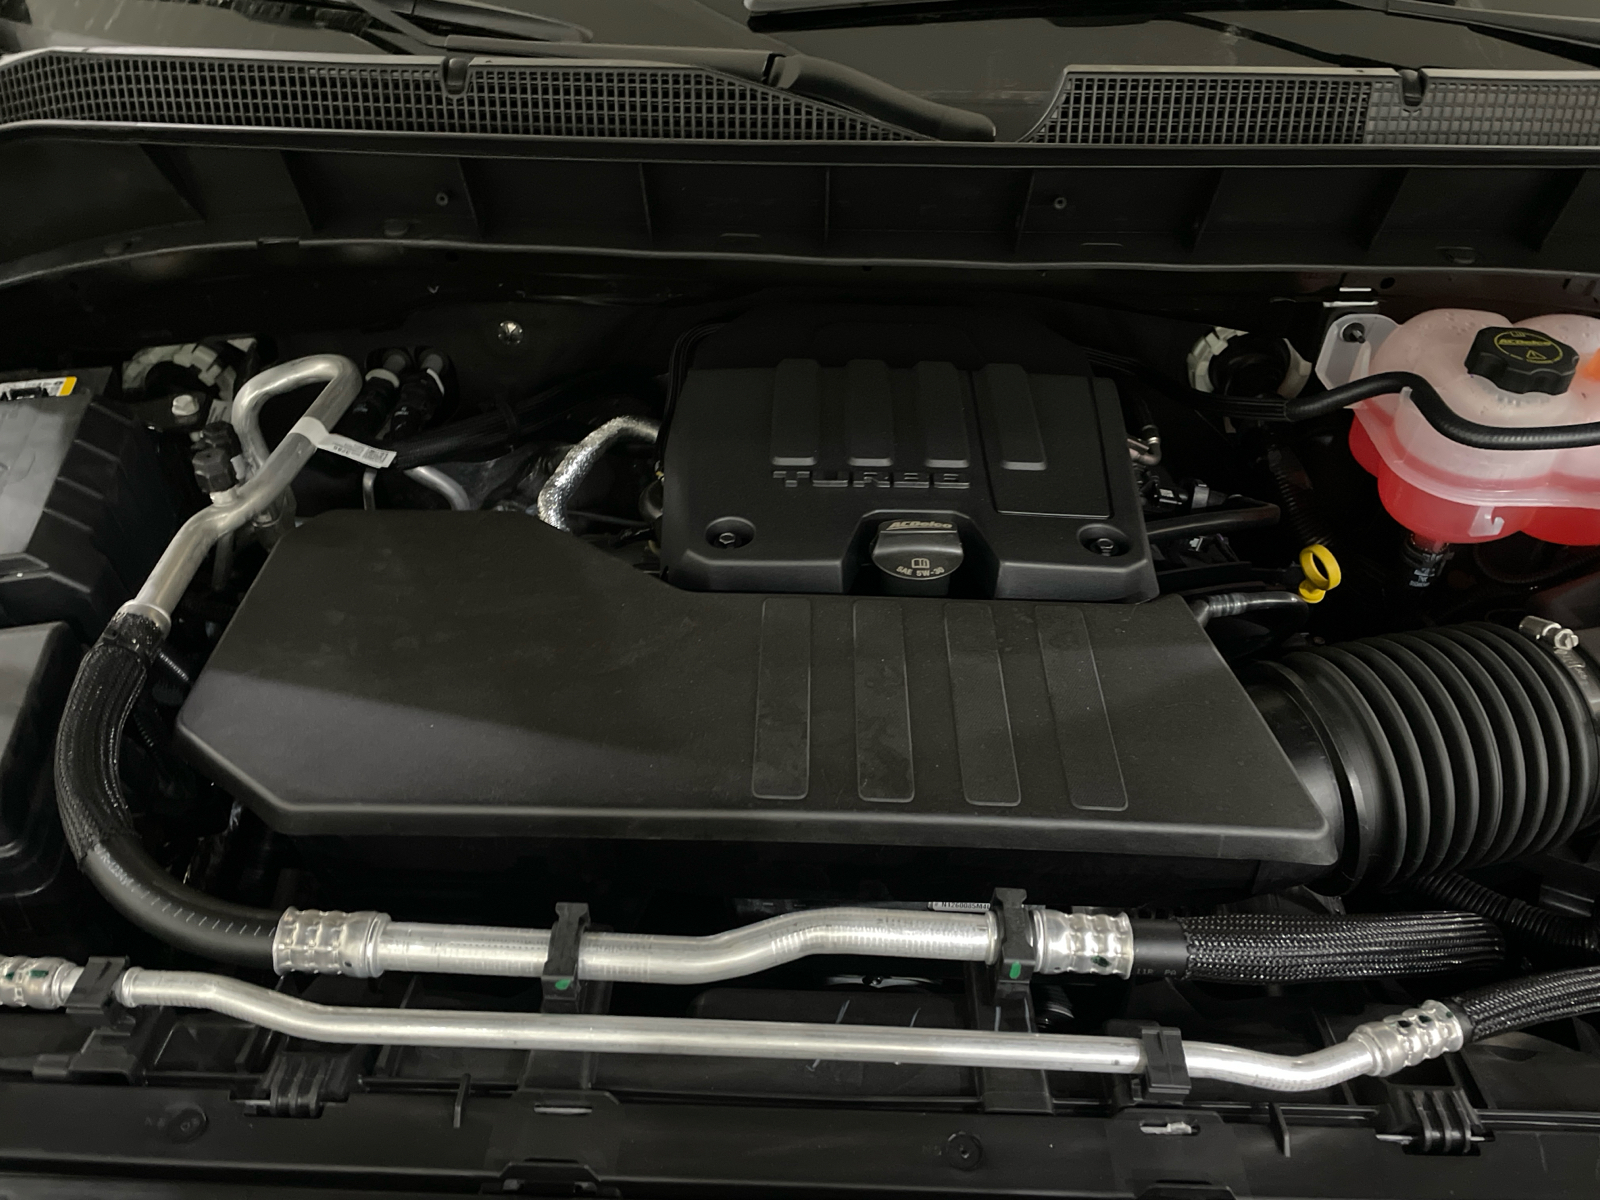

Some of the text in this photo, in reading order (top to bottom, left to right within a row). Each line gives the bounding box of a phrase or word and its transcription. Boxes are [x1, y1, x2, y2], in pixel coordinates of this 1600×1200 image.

[772, 469, 971, 490] TURBO
[885, 521, 953, 530] ACDelco
[896, 565, 945, 577] SAE 5W-30
